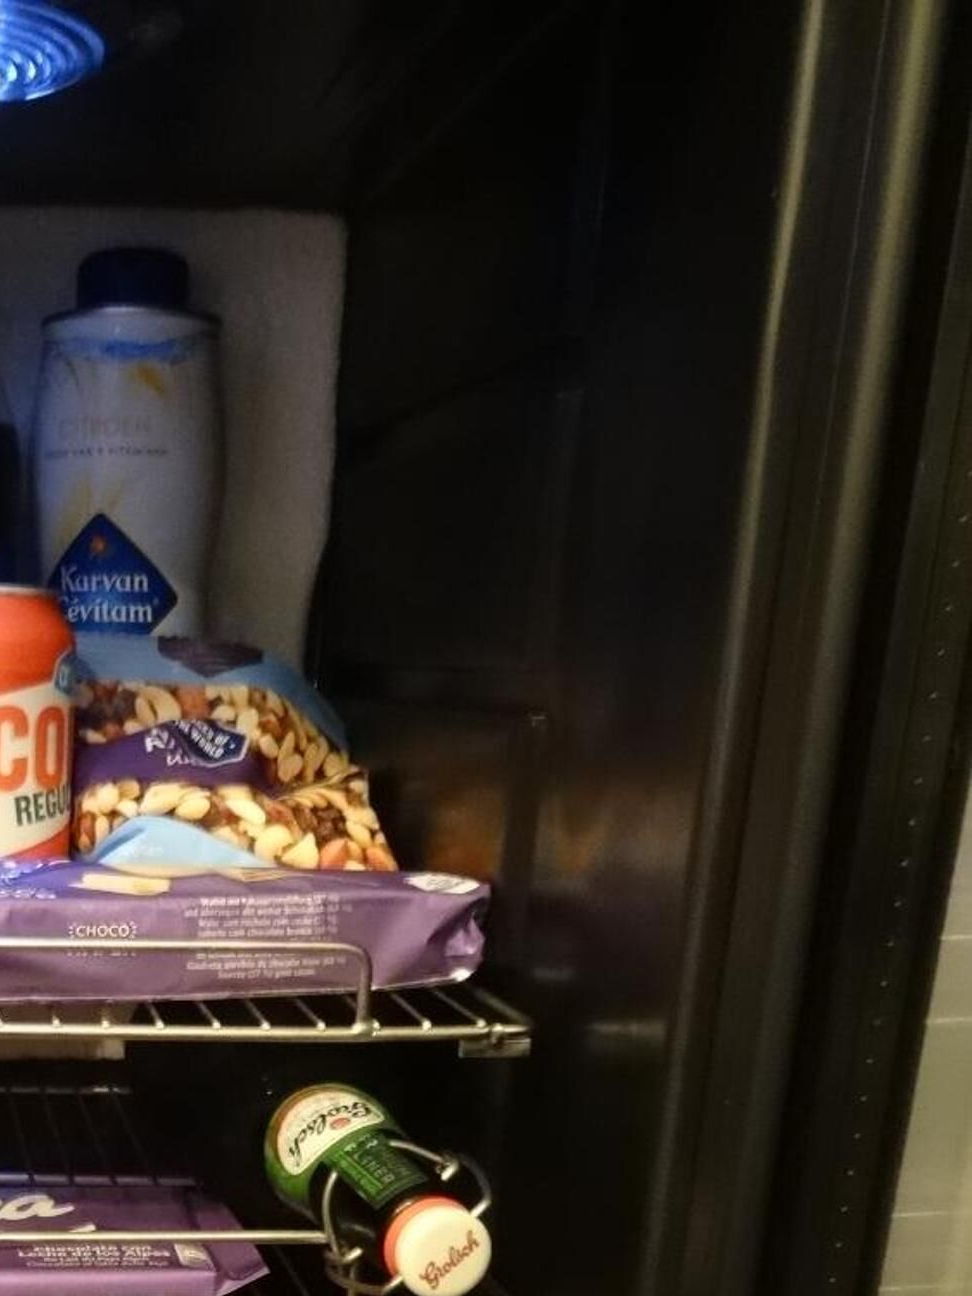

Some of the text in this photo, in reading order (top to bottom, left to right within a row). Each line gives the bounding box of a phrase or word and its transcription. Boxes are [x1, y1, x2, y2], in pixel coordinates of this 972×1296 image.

[60, 565, 149, 593] Karvan
[76, 923, 130, 938] CHOCO
[418, 1230, 481, 1291] Grolsch
